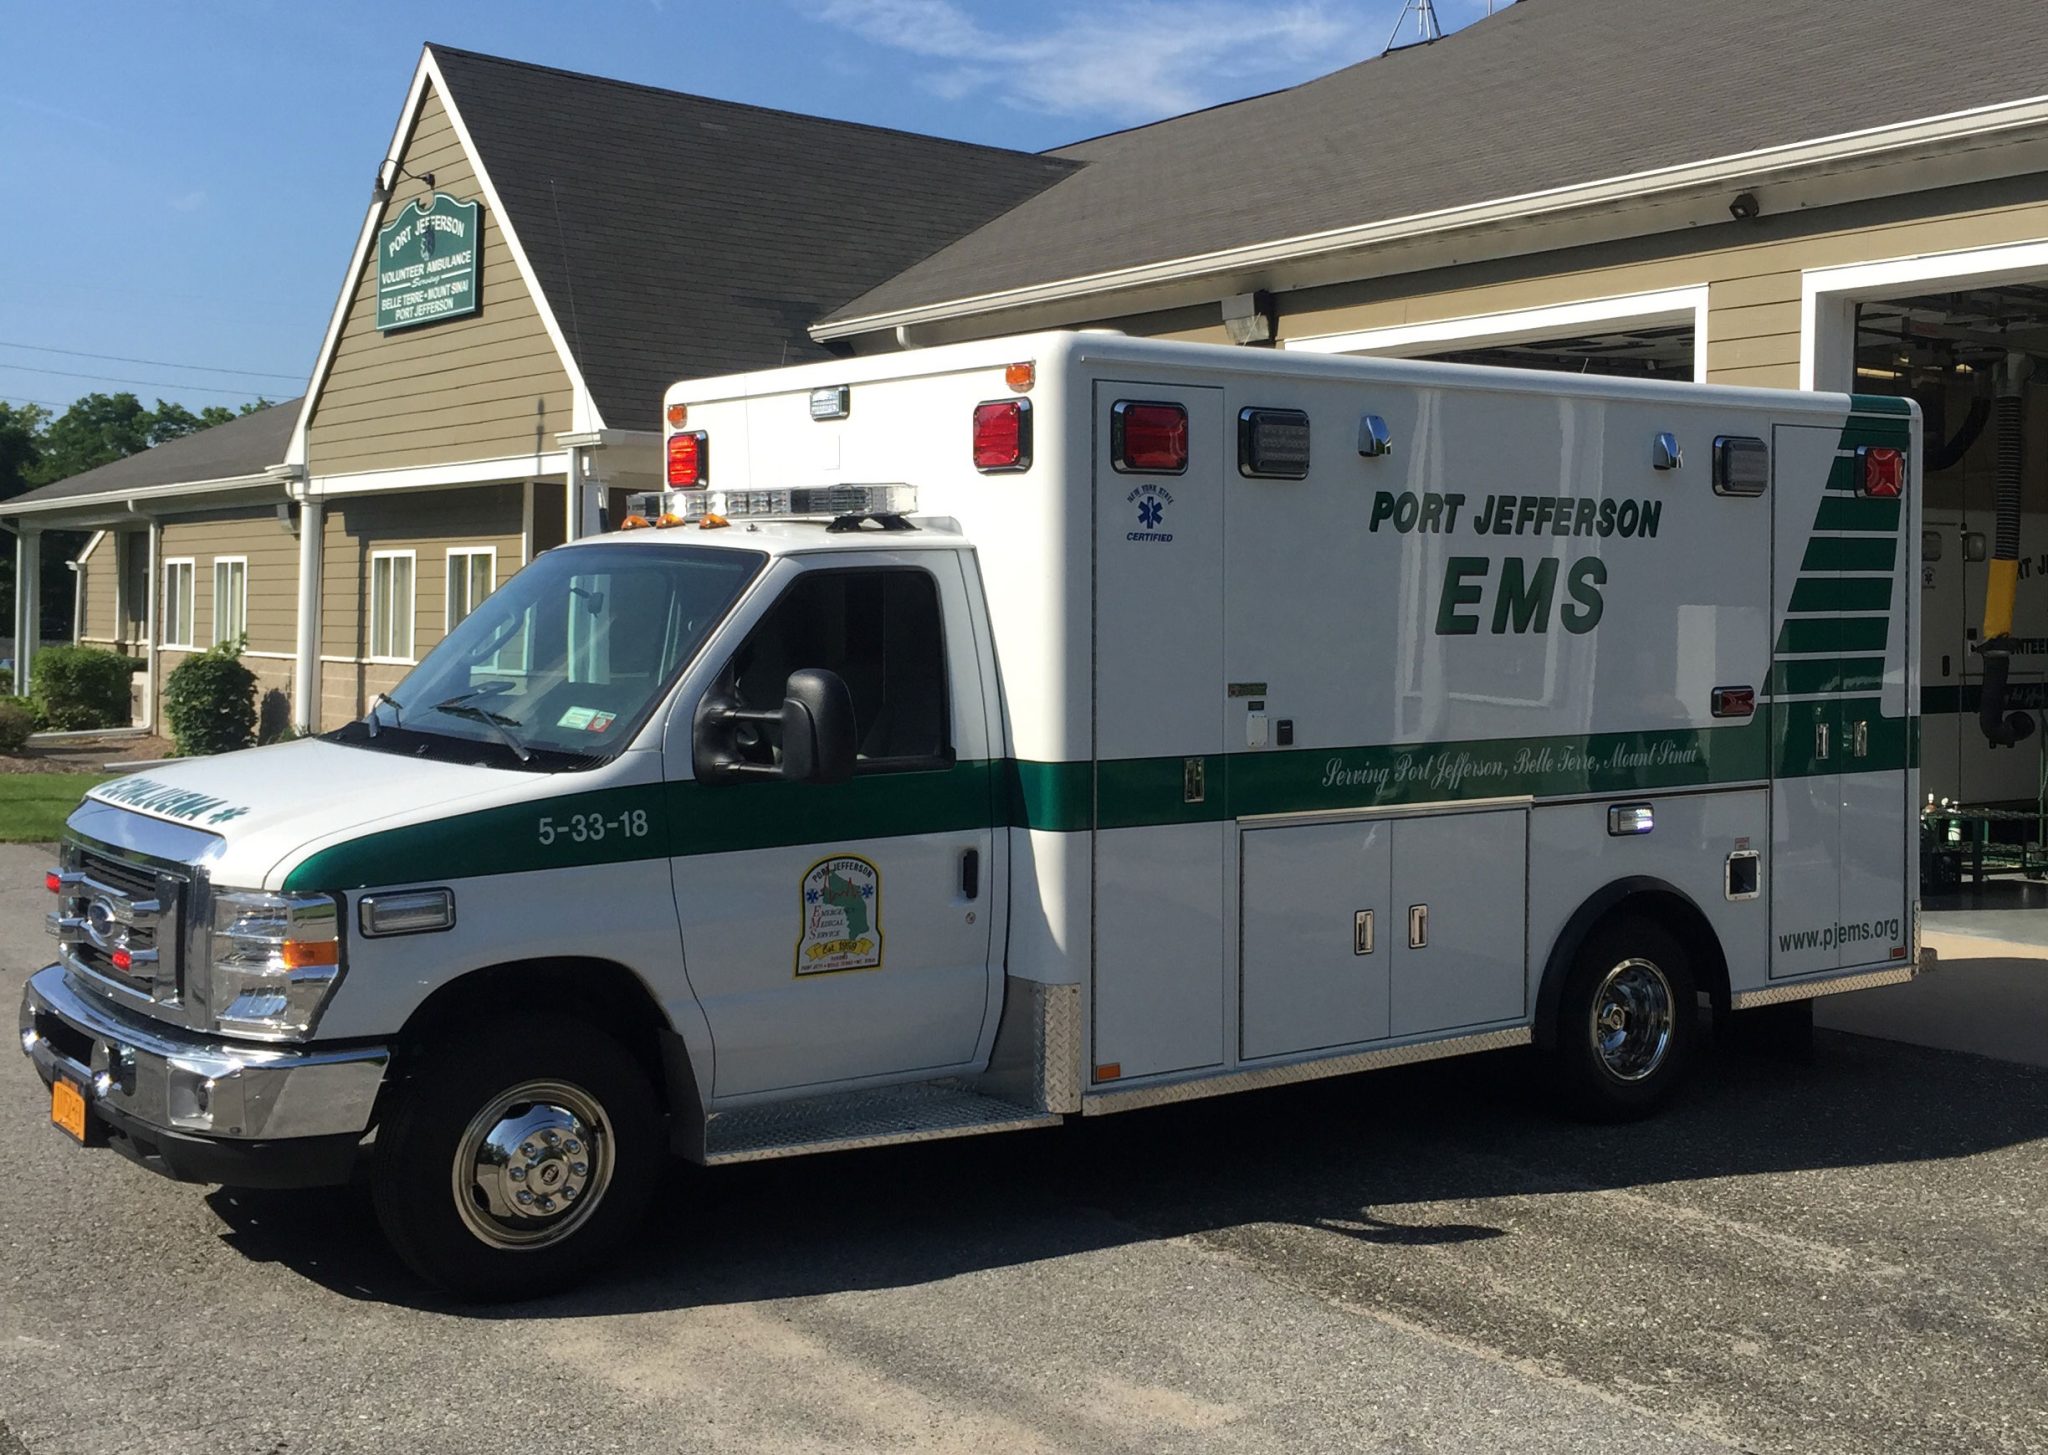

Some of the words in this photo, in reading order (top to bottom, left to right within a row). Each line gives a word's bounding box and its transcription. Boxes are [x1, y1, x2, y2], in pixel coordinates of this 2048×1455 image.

[388, 225, 412, 258] PORT
[415, 215, 465, 238] JEFFERSON
[381, 263, 425, 285] VOLUNTEER
[426, 250, 472, 275] AMBULANCE
[381, 297, 402, 311] BELLE
[402, 291, 424, 306] TERRE
[427, 284, 450, 300] MOUNT
[450, 279, 469, 294] SINAI
[395, 305, 414, 321] PORT
[414, 297, 454, 317] JEFFERSON
[1369, 491, 1466, 534] PORT
[1473, 494, 1662, 538] JEFFERSON
[1126, 532, 1173, 542] CERTIFIED
[1435, 556, 1608, 635] EMS
[1322, 757, 1390, 796] Serving
[1394, 753, 1434, 782] Port
[1430, 751, 1508, 790] Jefferson,
[1513, 746, 1553, 774] Belle
[1557, 745, 1600, 775] Terre,
[1603, 742, 1657, 769] Mount
[1657, 739, 1698, 766] Sinai
[538, 809, 649, 846] 5-33-18
[812, 864, 830, 883] PORT
[833, 861, 873, 878] JEFFERSON
[1779, 918, 1899, 952] www.pjems.org
